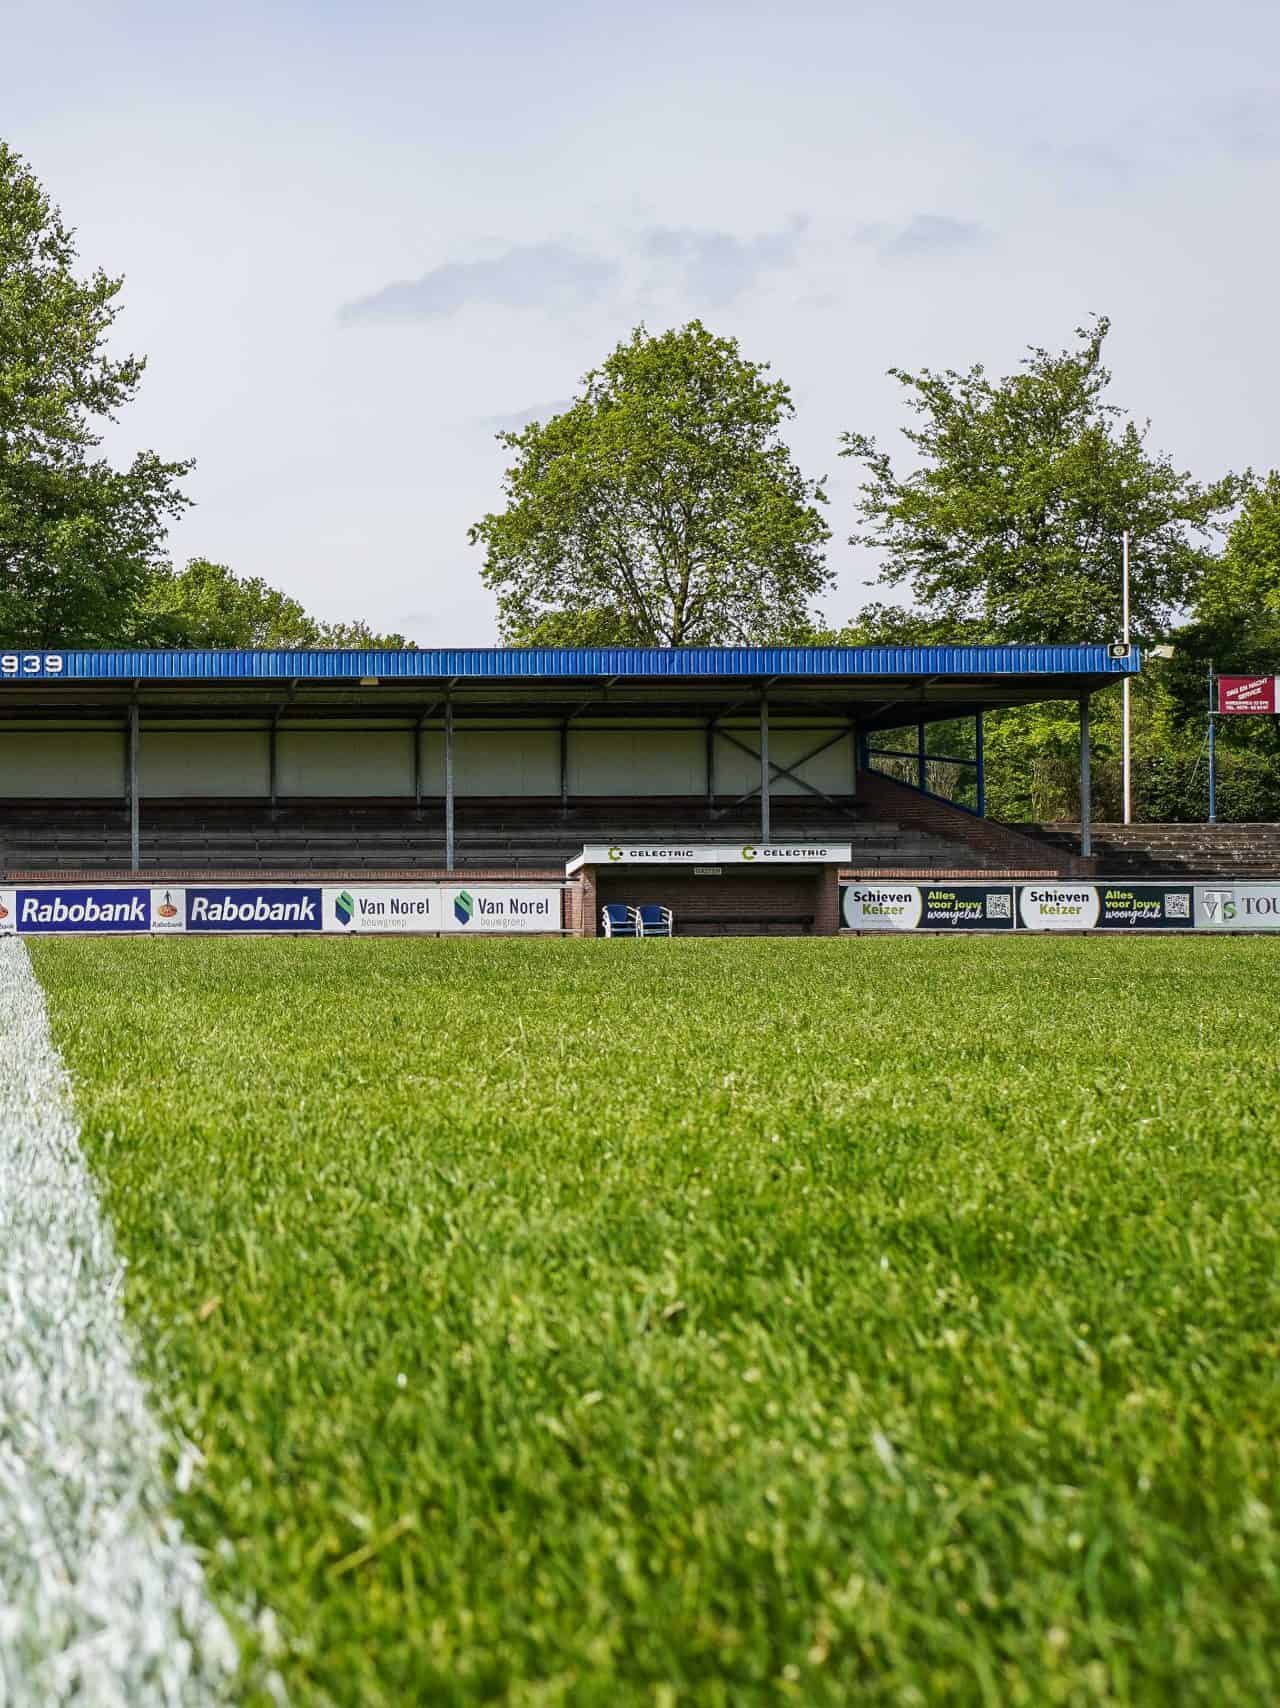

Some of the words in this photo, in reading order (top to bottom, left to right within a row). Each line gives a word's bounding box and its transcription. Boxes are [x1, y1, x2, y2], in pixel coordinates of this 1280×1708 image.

[629, 850, 694, 858] CELECTRIC
[763, 849, 828, 857] CELECTRIC
[853, 890, 912, 903] Schieven
[927, 890, 956, 900] Alles
[1030, 890, 1089, 903] Schieven
[1105, 890, 1134, 900] Alles
[21, 896, 146, 923] Rabobank
[191, 895, 317, 921] Rabobank
[358, 898, 385, 915] Van
[390, 898, 430, 915] Norel
[478, 898, 505, 915] Van
[509, 898, 549, 915] Norel
[862, 902, 904, 916] Keizer
[927, 901, 953, 909] voor
[954, 900, 982, 911] jouw
[1039, 902, 1082, 916] Keizer
[1105, 900, 1130, 909] voor
[1132, 900, 1161, 910] jouw
